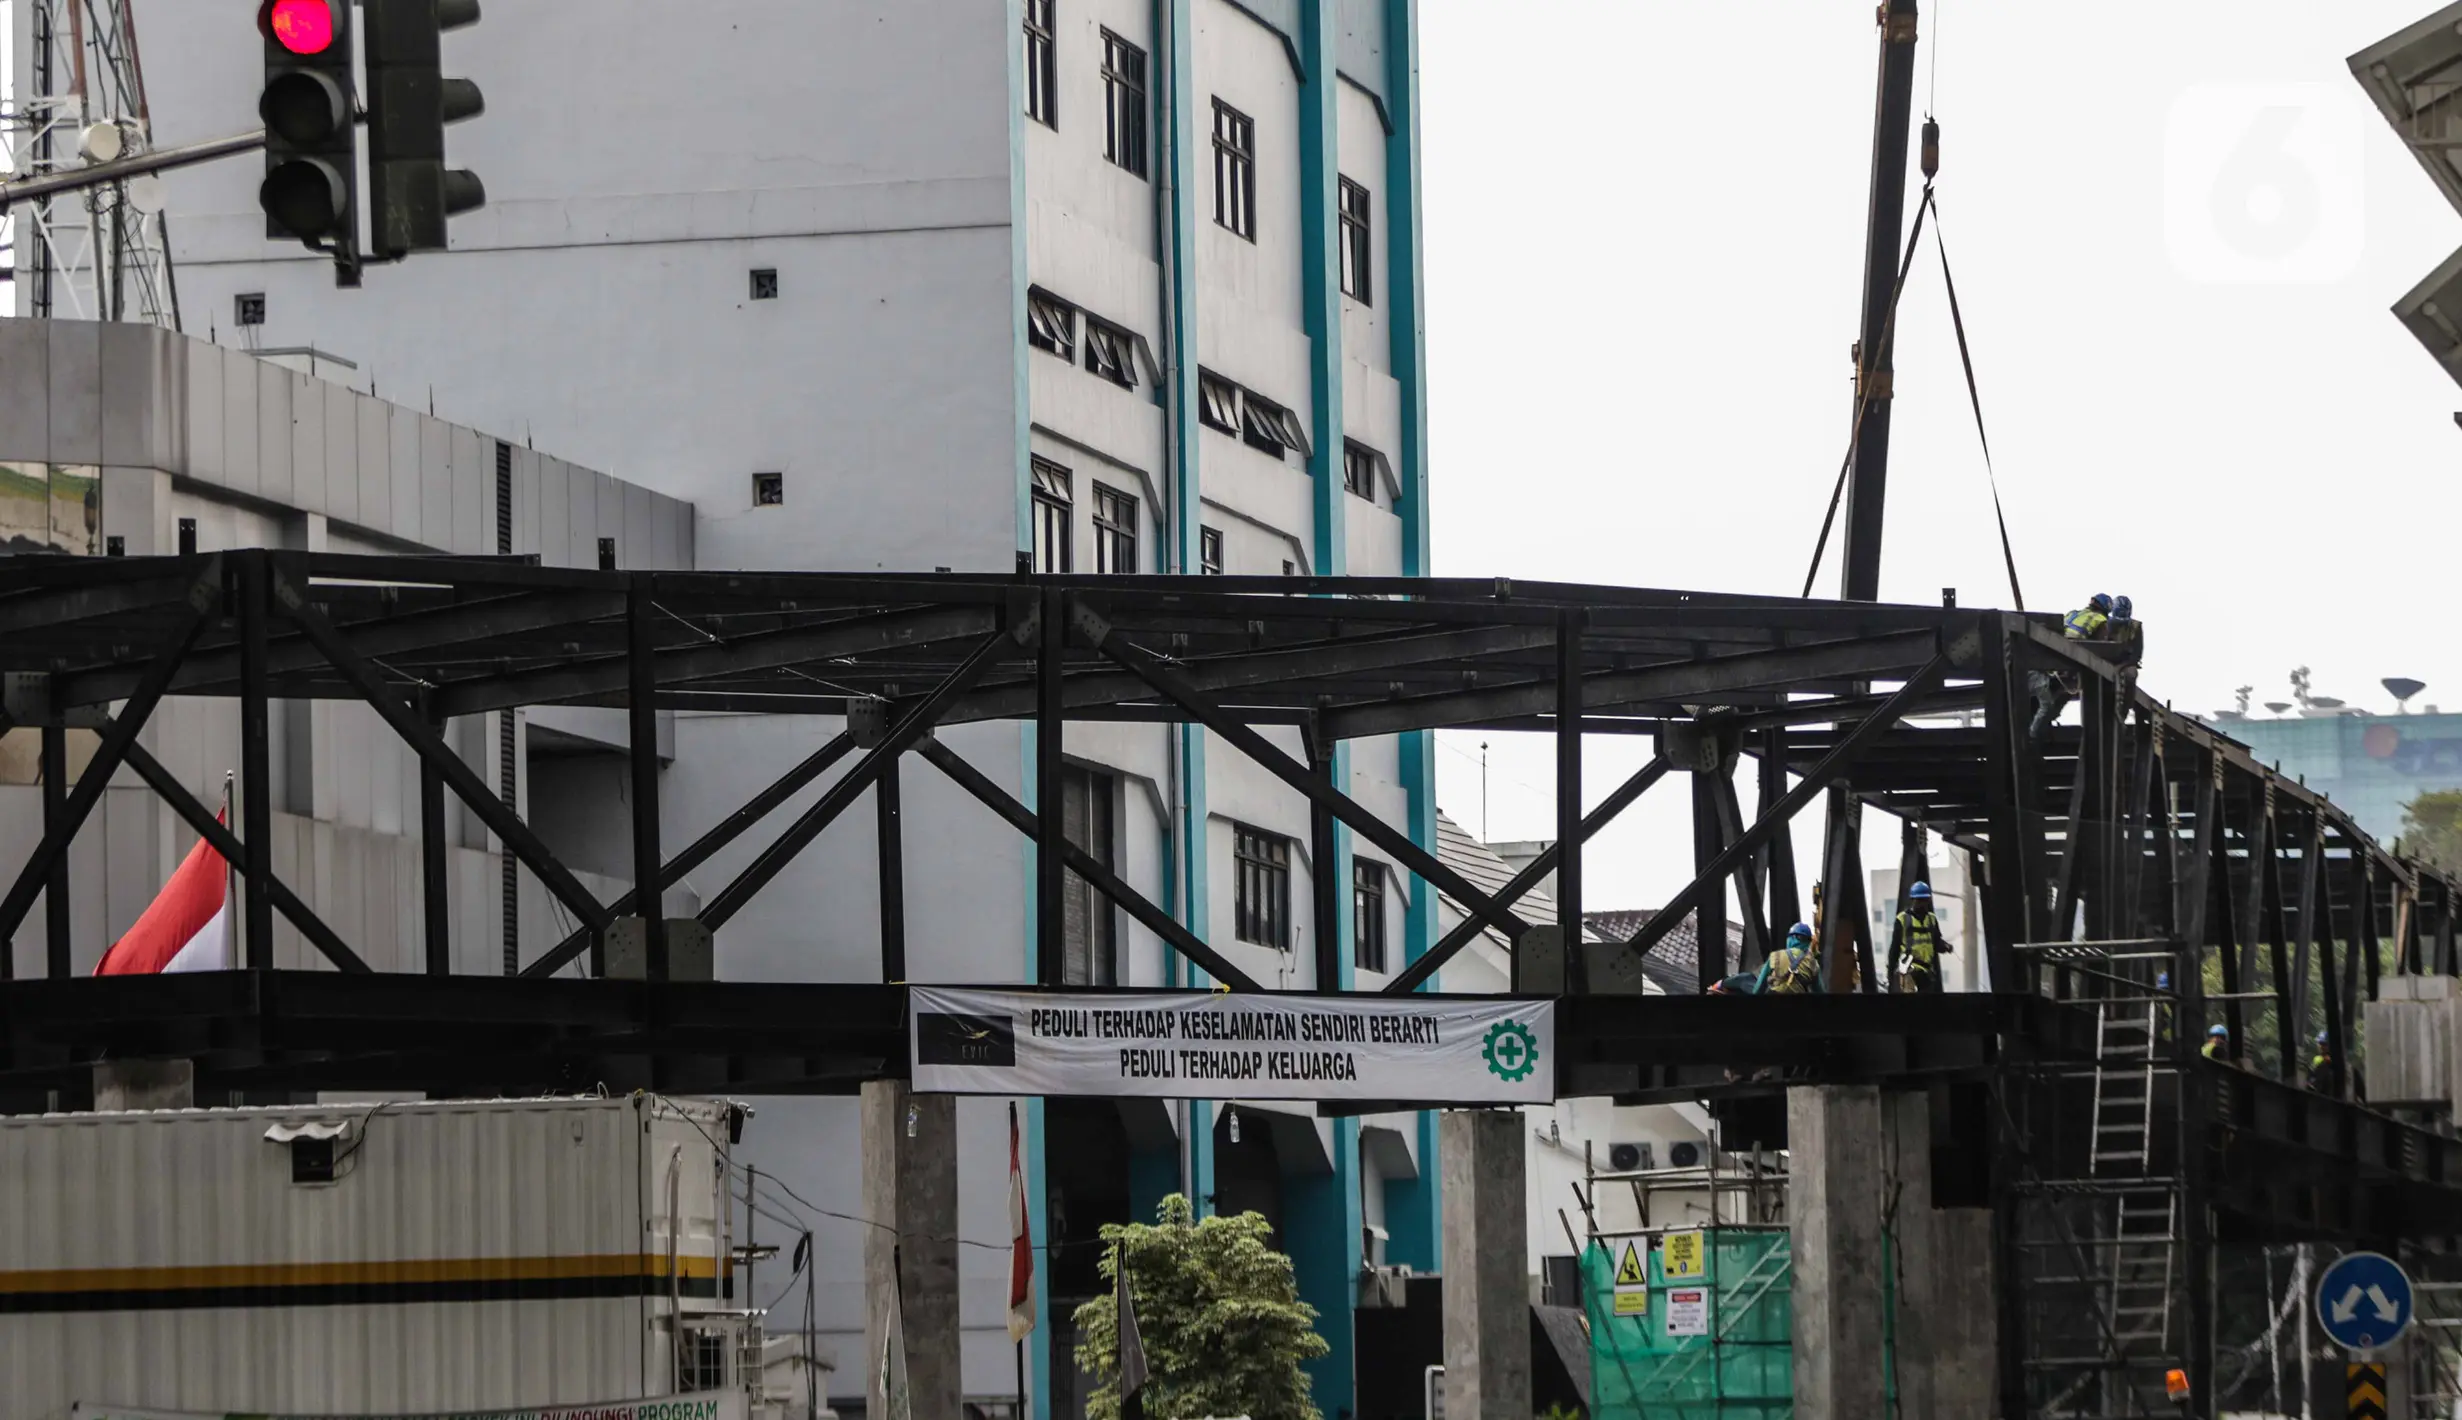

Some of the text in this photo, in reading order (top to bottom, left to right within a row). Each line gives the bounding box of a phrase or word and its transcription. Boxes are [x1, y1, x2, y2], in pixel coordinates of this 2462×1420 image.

[1031, 1008, 1440, 1044] PEDULI TERHADAP KESELAMATAN SENDIRI BERARTI
[1120, 1049, 1357, 1081] PEDULI TERHADAP KELUARGA
[638, 1400, 718, 1420] PROGRAM
